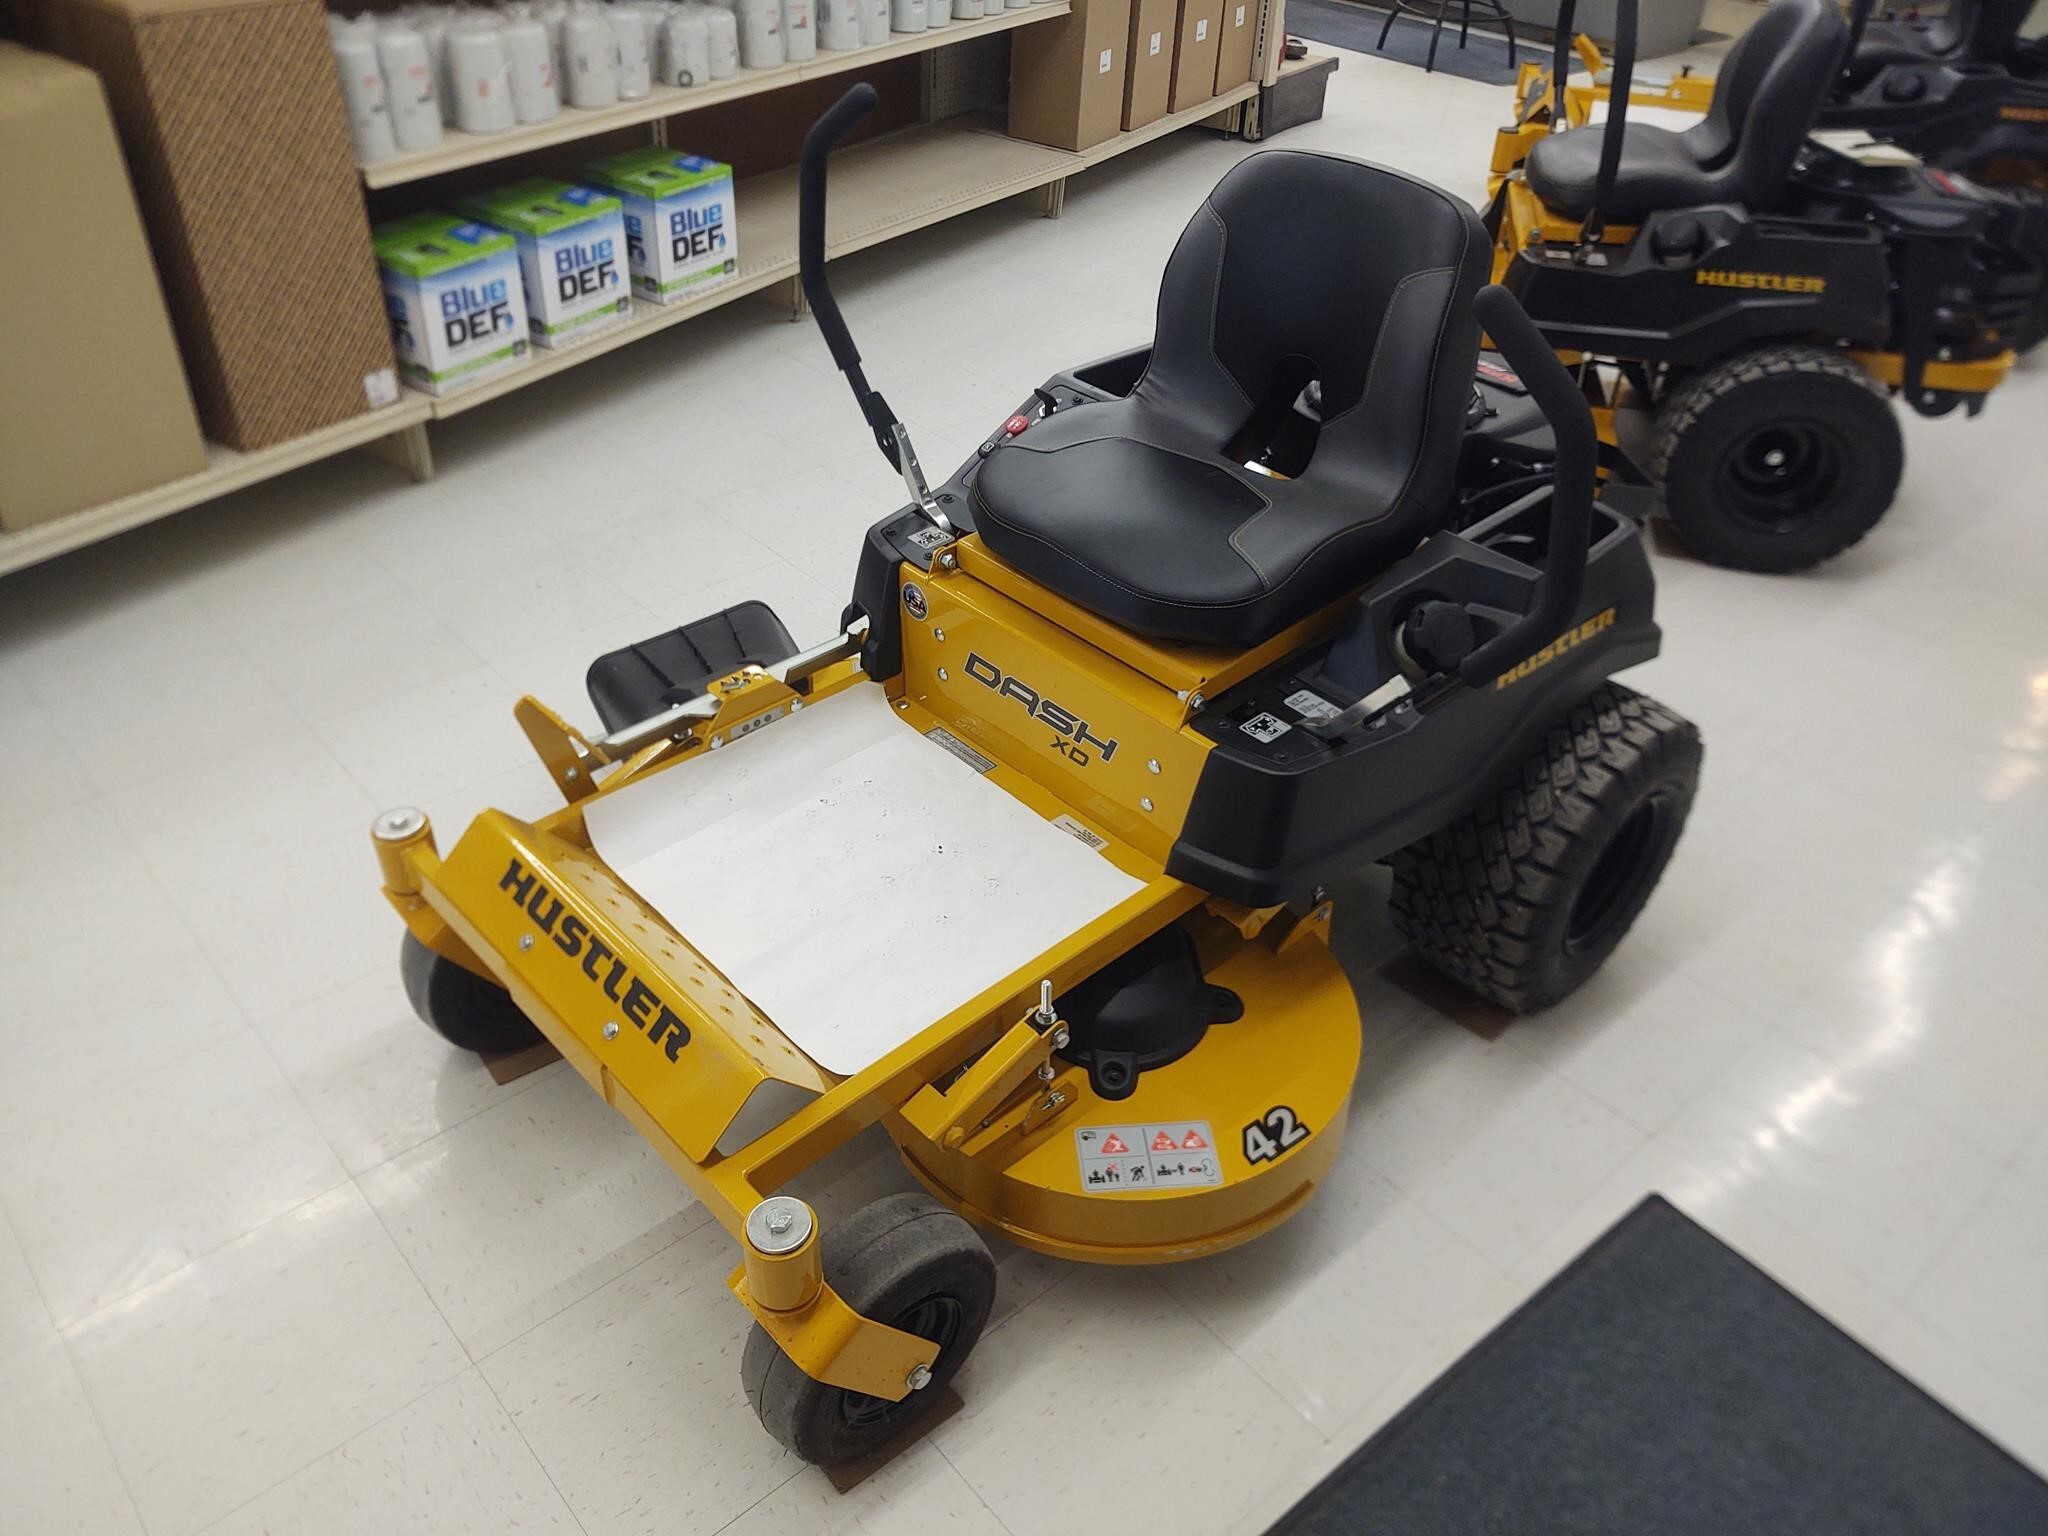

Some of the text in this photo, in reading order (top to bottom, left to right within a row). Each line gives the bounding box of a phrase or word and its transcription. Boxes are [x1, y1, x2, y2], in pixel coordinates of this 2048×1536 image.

[670, 203, 723, 236] Blue
[555, 238, 614, 274] Blue
[673, 223, 723, 263] DEF
[440, 277, 507, 317] Blue
[559, 260, 615, 303] DEF
[1696, 269, 1825, 293] HUSTLER
[445, 301, 508, 347] DEF
[903, 590, 927, 614] USA
[963, 651, 1119, 763] DASH
[1050, 735, 1089, 767] XD
[499, 858, 692, 1064] HUSTLER
[1242, 1105, 1311, 1166] 42
